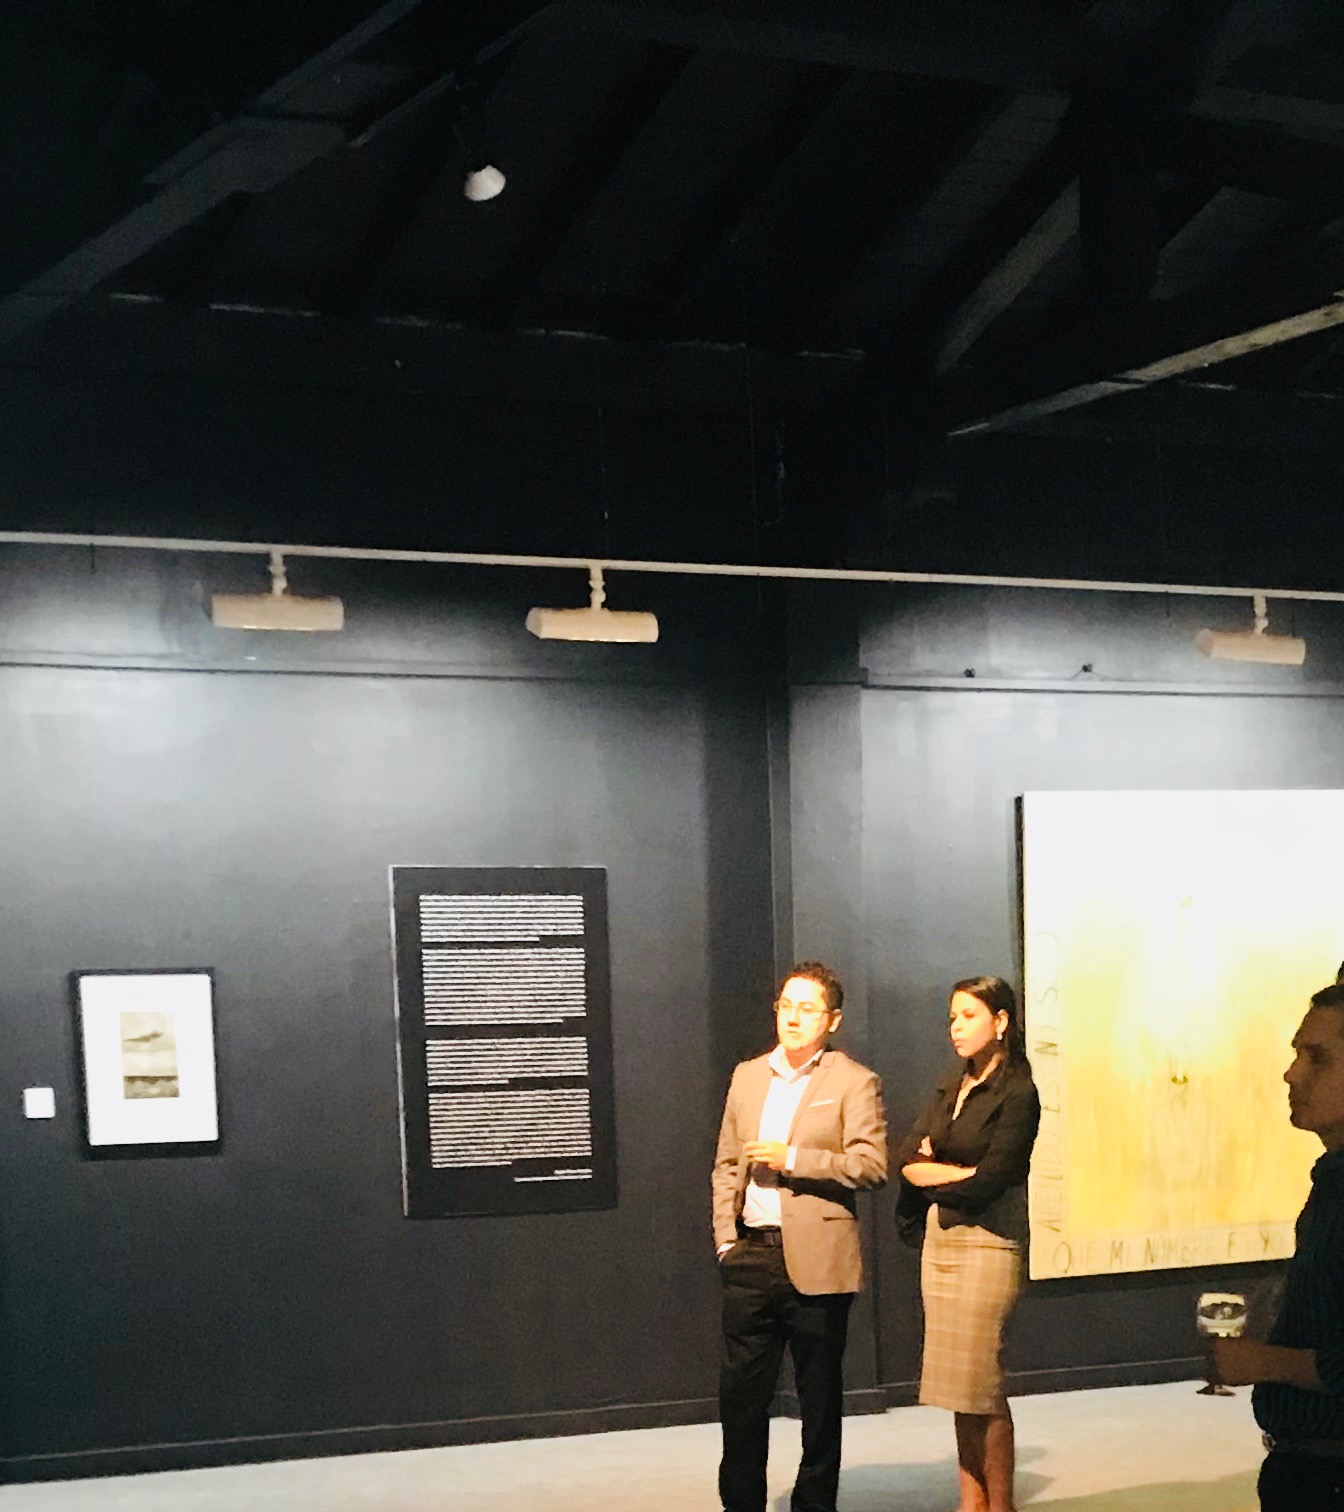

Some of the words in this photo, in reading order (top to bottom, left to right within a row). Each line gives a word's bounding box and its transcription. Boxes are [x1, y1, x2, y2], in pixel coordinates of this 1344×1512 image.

[1052, 1240, 1097, 1274] QUE
[1110, 1240, 1131, 1265] MI
[1144, 1234, 1215, 1263] NOMBRE
[1258, 1229, 1283, 1253] YO
